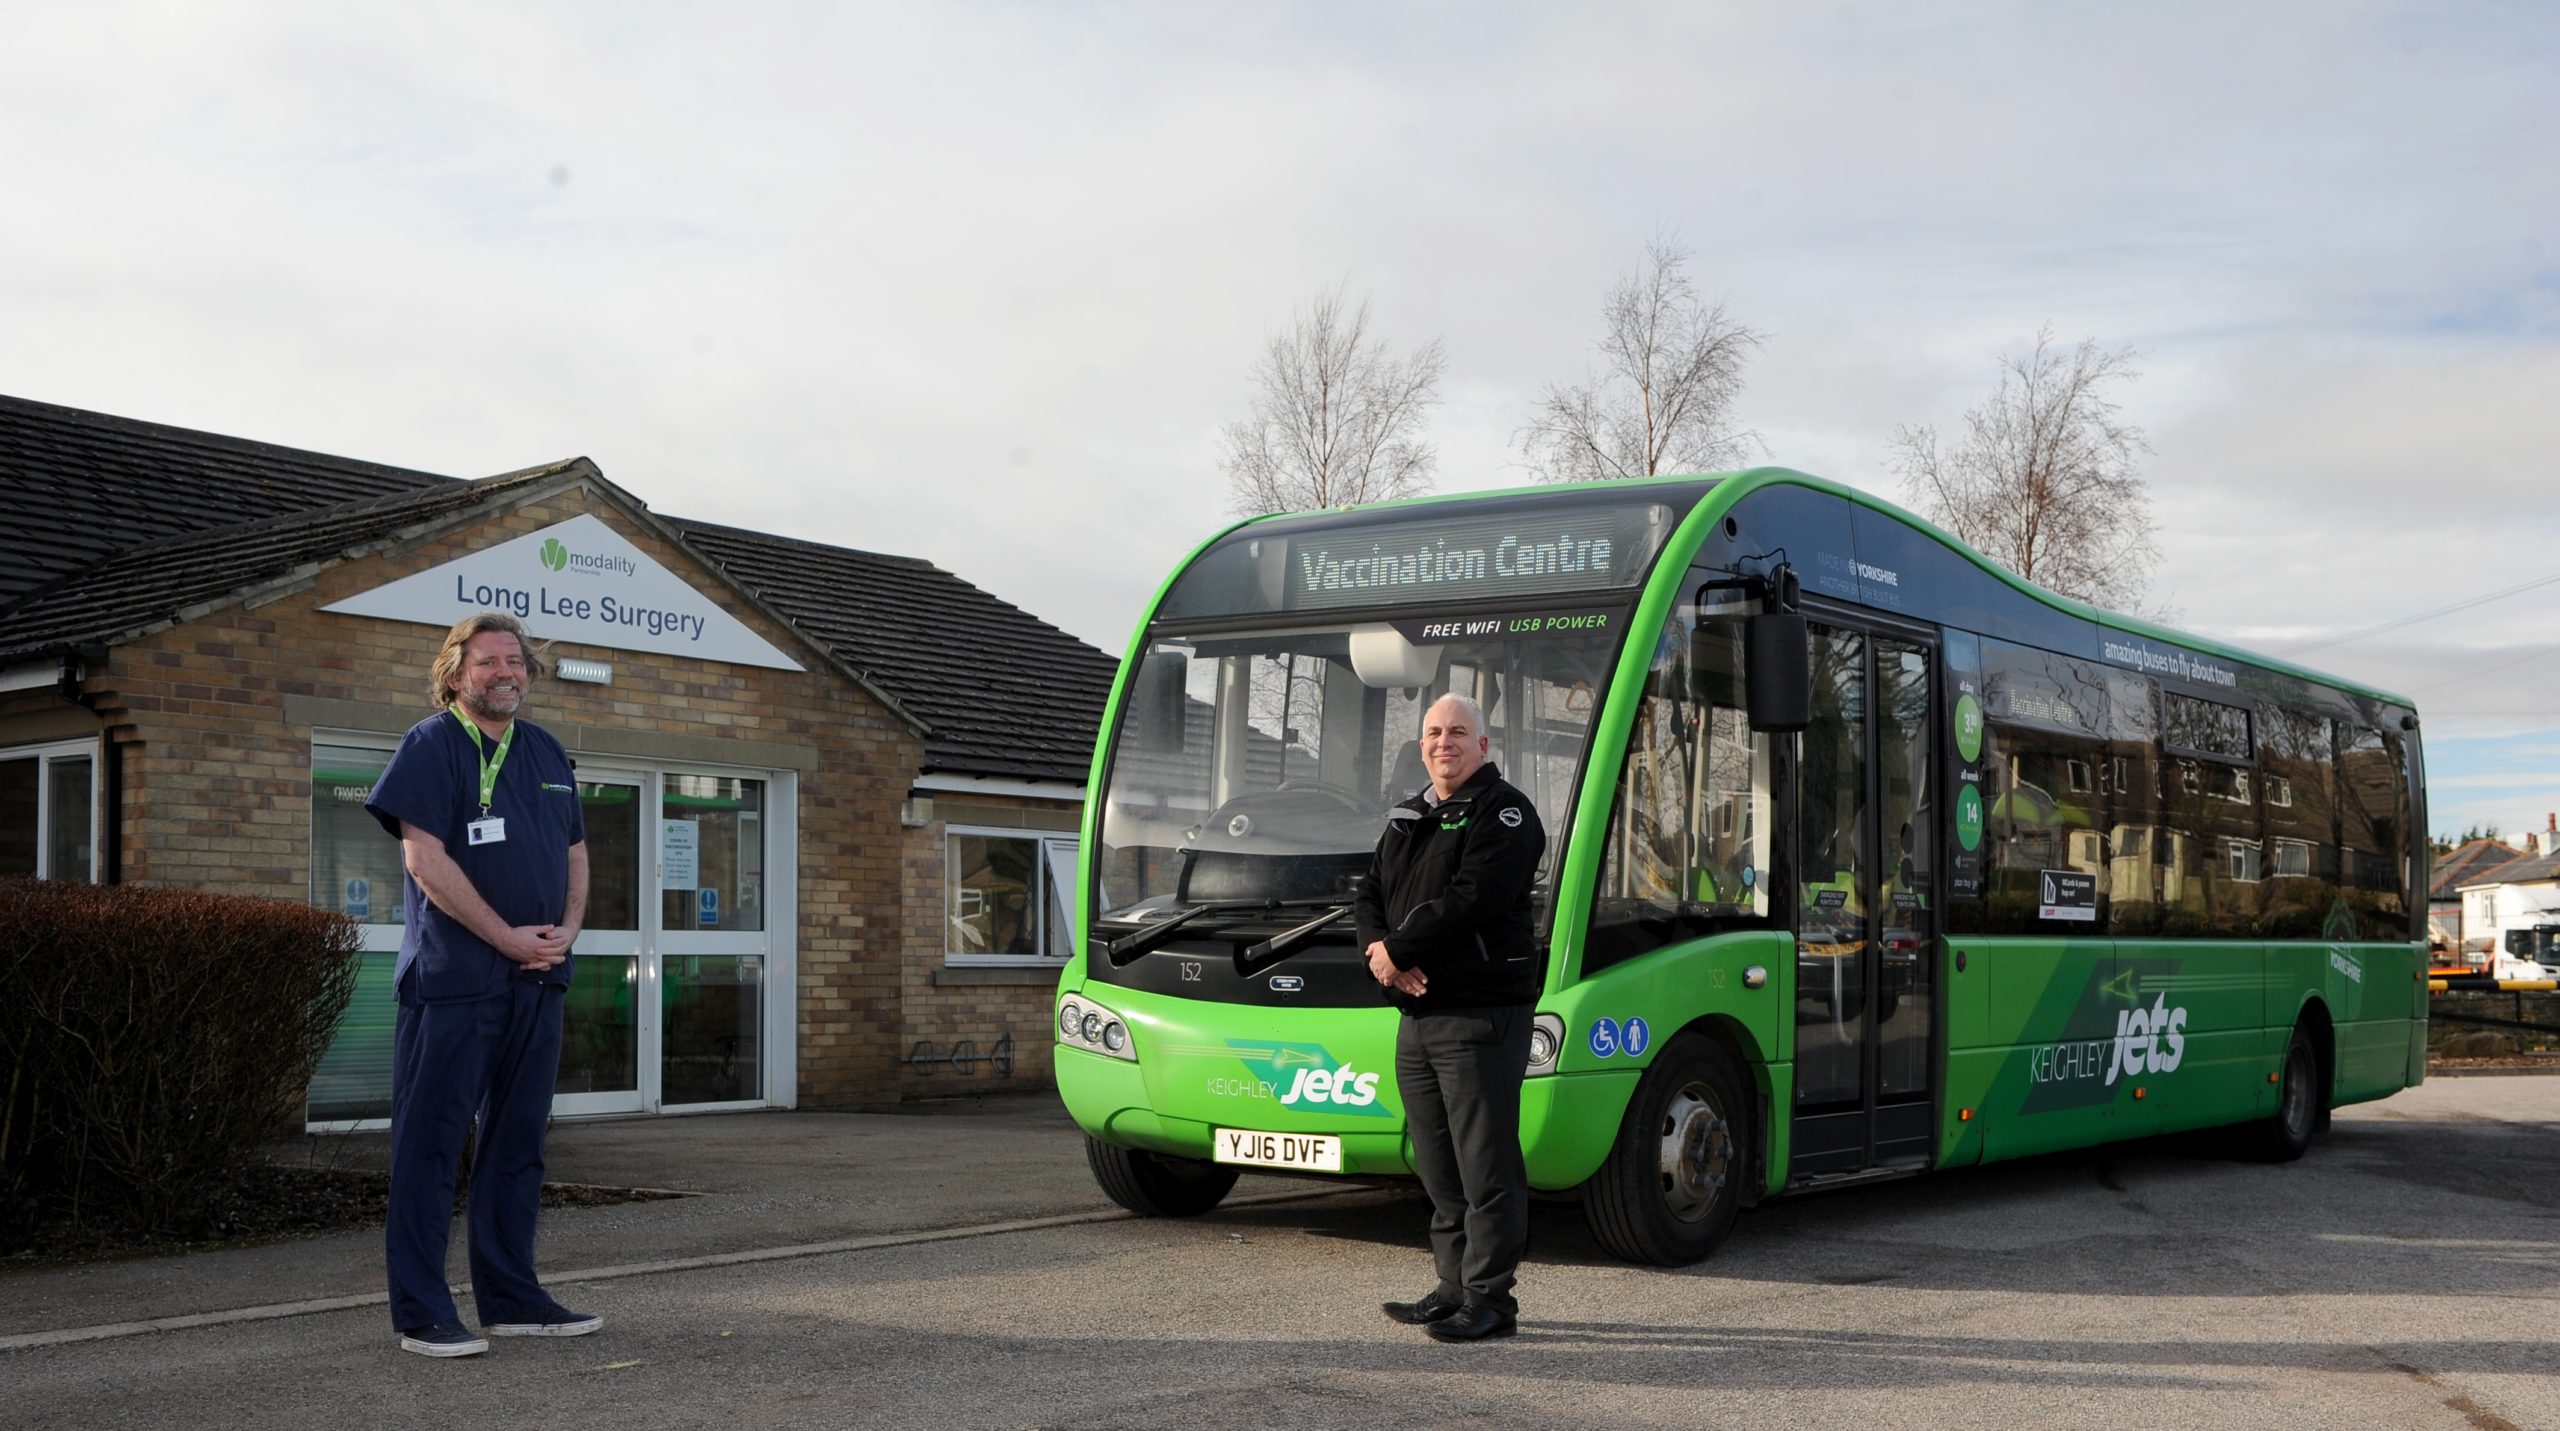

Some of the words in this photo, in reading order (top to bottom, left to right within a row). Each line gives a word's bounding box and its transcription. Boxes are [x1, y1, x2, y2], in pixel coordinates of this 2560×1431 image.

[570, 554, 636, 577] modality
[1302, 538, 1486, 591] Vaccination
[1496, 535, 1611, 577] Centre
[1857, 562, 1898, 587] YORKSHIRE
[457, 575, 531, 618] Long
[541, 587, 591, 619] Lee
[600, 596, 705, 641] Surgery
[1423, 623, 1460, 638] FREE
[1466, 620, 1501, 636] WIFI
[1509, 618, 1541, 632] USB
[1545, 615, 1607, 631] POWER
[2104, 641, 2143, 671] amazing
[2143, 644, 2168, 672] buses
[2169, 657, 2179, 674] to
[2179, 653, 2190, 681] fly
[2191, 658, 2215, 682] about
[2215, 665, 2236, 687] town
[1966, 802, 1978, 823] 14
[1180, 962, 1202, 981] 152
[1707, 968, 1725, 989] 152
[2031, 1042, 2106, 1084] KEIGHLEY
[2105, 991, 2188, 1086] jets
[1207, 1078, 1278, 1098] KEIGHLEY
[1280, 1062, 1381, 1107] jets
[1230, 1133, 1276, 1161] YJ16
[1283, 1137, 1326, 1163] DVF
